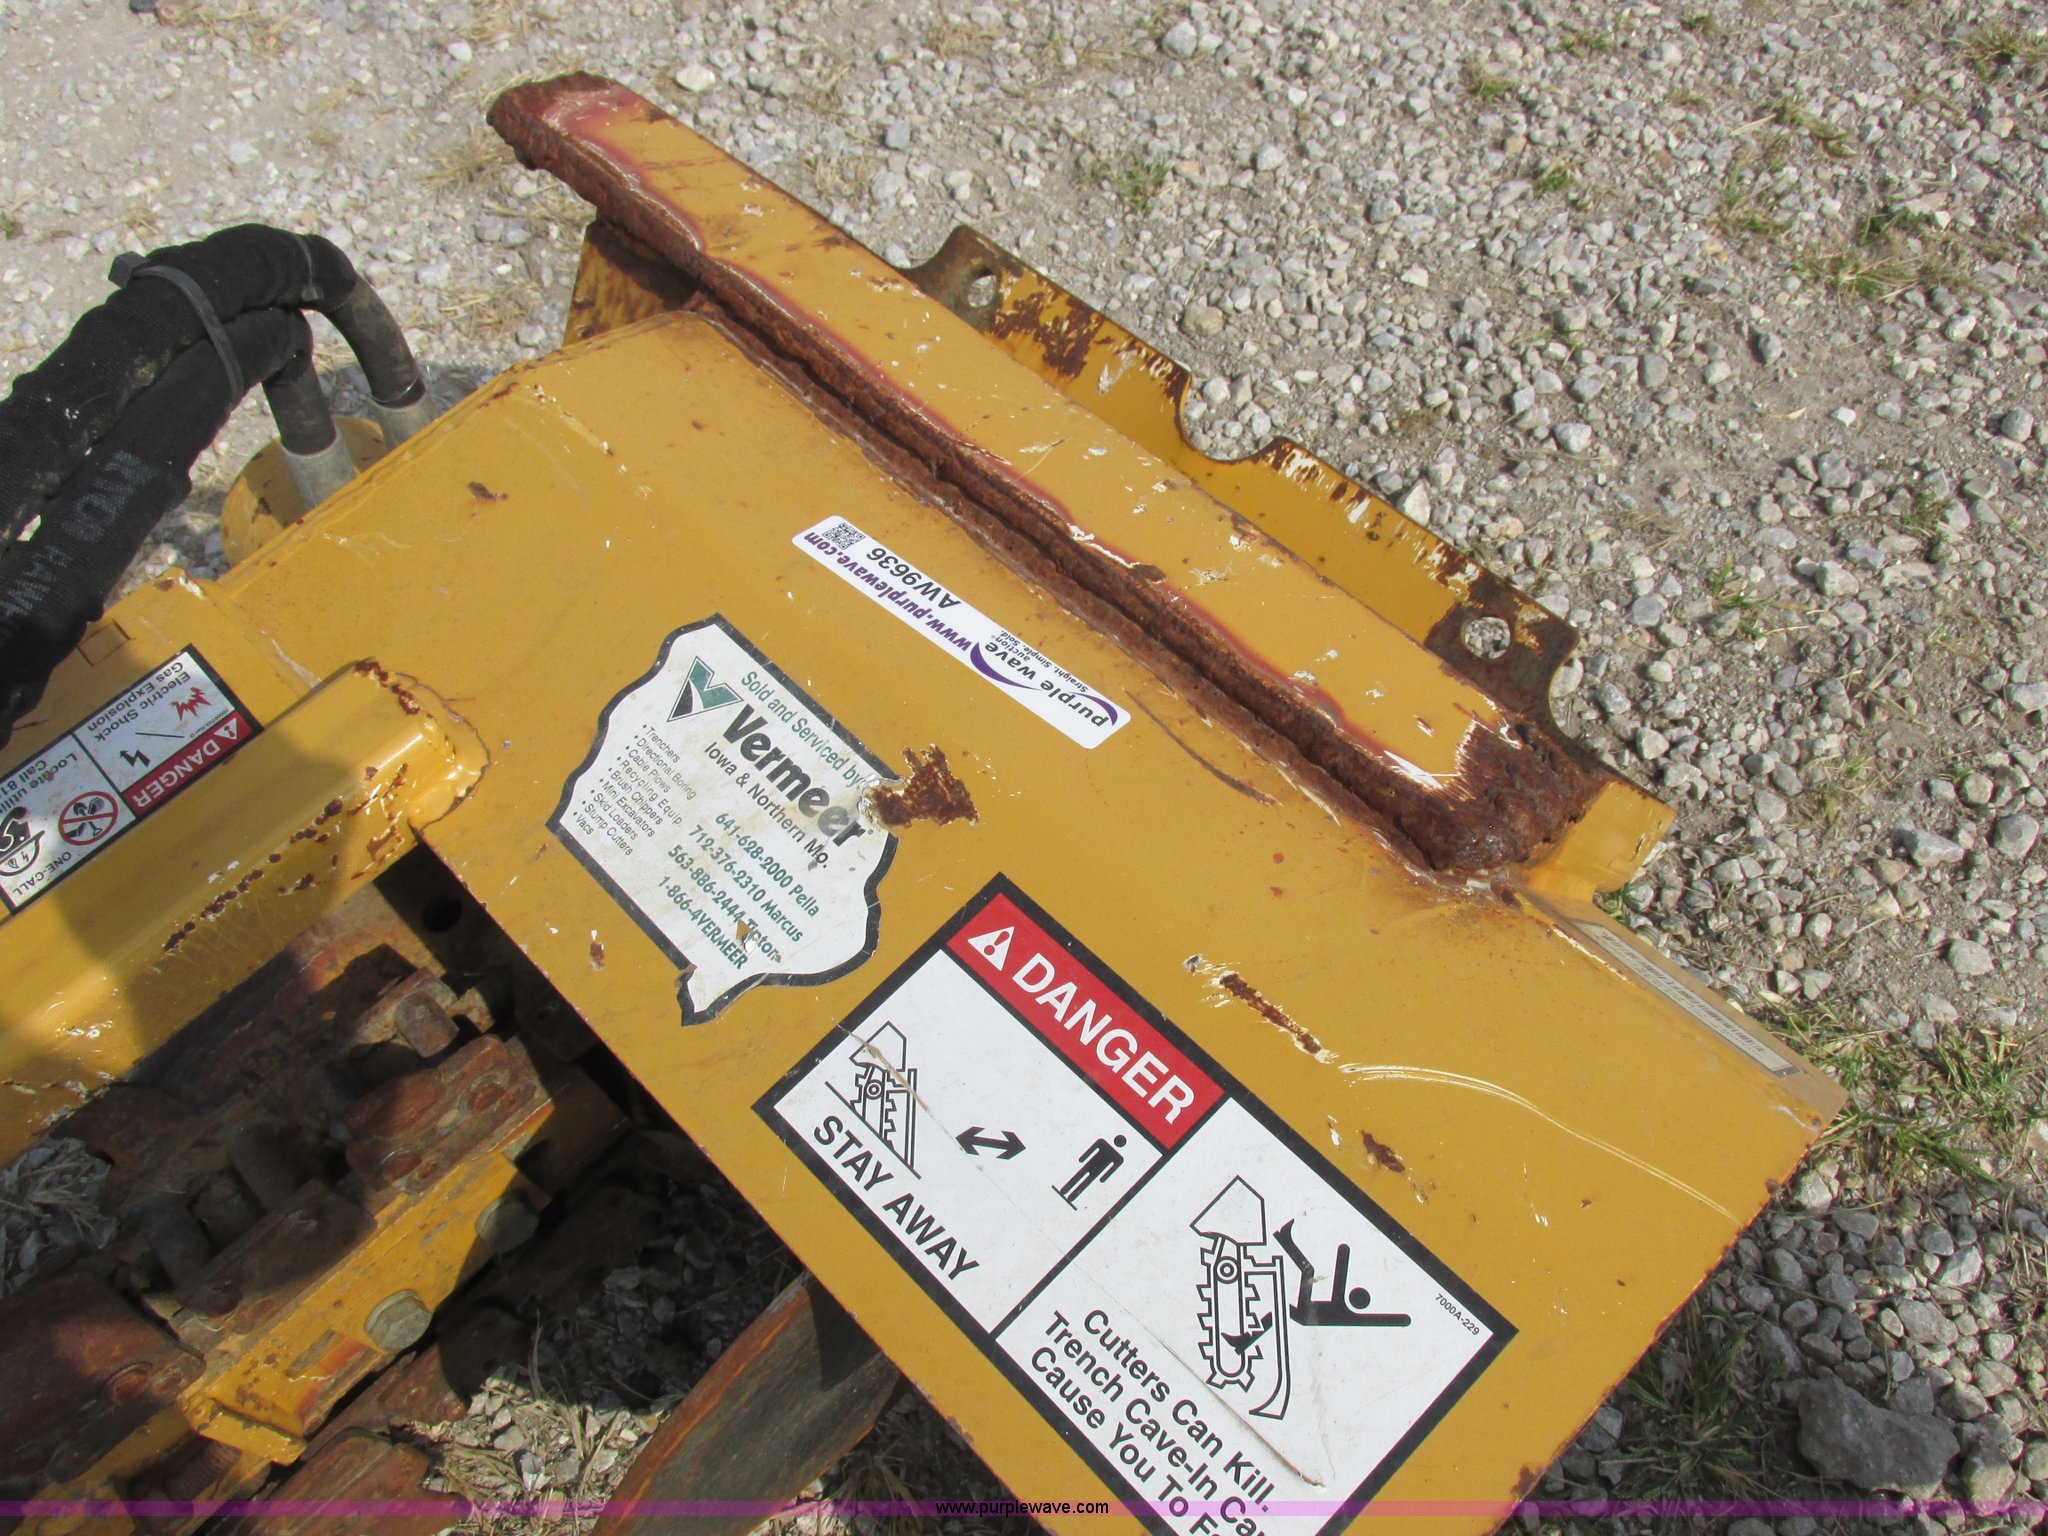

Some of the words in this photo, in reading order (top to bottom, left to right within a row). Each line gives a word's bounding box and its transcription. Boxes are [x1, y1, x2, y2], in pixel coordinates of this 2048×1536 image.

[803, 531, 972, 652] www.purplewave.com
[866, 547, 962, 609] AW9636
[155, 662, 183, 682] Gas
[984, 641, 1037, 680] wave
[995, 636, 1031, 662] auction
[87, 682, 155, 731] Explosion
[139, 671, 191, 710] Electric
[1040, 680, 1109, 727] purple
[95, 709, 138, 741] Shock
[646, 727, 680, 763] Trenchers
[741, 671, 775, 702] Sold
[767, 701, 798, 723] and
[791, 718, 850, 771] Serviced
[0, 780, 17, 798] 81
[18, 760, 47, 783] Call
[29, 753, 78, 789] Locate
[132, 739, 221, 807] DANGER
[620, 760, 659, 802] Recycling
[658, 798, 683, 827] Equip.
[628, 749, 650, 772] Cable
[648, 769, 671, 793] Plows
[636, 738, 675, 776] Directional
[672, 773, 696, 800] Boring
[723, 703, 866, 847] Vermeer
[0, 788, 27, 814] utili
[575, 814, 594, 835] Vacs
[593, 792, 611, 812] Skid
[608, 809, 638, 840] Loaders
[602, 781, 619, 799] Mini
[616, 796, 655, 838] Excavators
[610, 770, 632, 793] Brush
[630, 791, 663, 825] Chippers
[704, 742, 738, 775] Iowa
[735, 772, 750, 788] &
[747, 782, 806, 843] Northern
[804, 838, 829, 869] Mo.
[584, 804, 608, 830] Stump
[606, 827, 633, 856] Cutters
[12, 851, 72, 895] ONE-CALL
[668, 844, 746, 923] 563-886-2444
[689, 824, 766, 902] 712-376-2310
[760, 899, 803, 942] Marcus
[715, 813, 793, 888] 641-628-2000
[788, 884, 820, 917] Pella
[658, 876, 748, 970] 1-866-4VERMEER
[1011, 951, 1196, 1125] DANGER
[813, 1114, 894, 1192] STAY
[882, 1192, 979, 1281] AWAY
[1435, 1293, 1480, 1336] 7000A-229
[1045, 1310, 1124, 1403] Trench
[1125, 1398, 1218, 1501] Cave-In
[1220, 1496, 1265, 1536] Ca
[1084, 1309, 1170, 1403] Cutters
[1172, 1399, 1223, 1457] Can
[1223, 1451, 1275, 1513] Kill.
[1031, 1347, 1106, 1429] Cause
[1108, 1422, 1156, 1483] You
[1157, 1474, 1189, 1517] To
[1189, 1512, 1221, 1536] F
